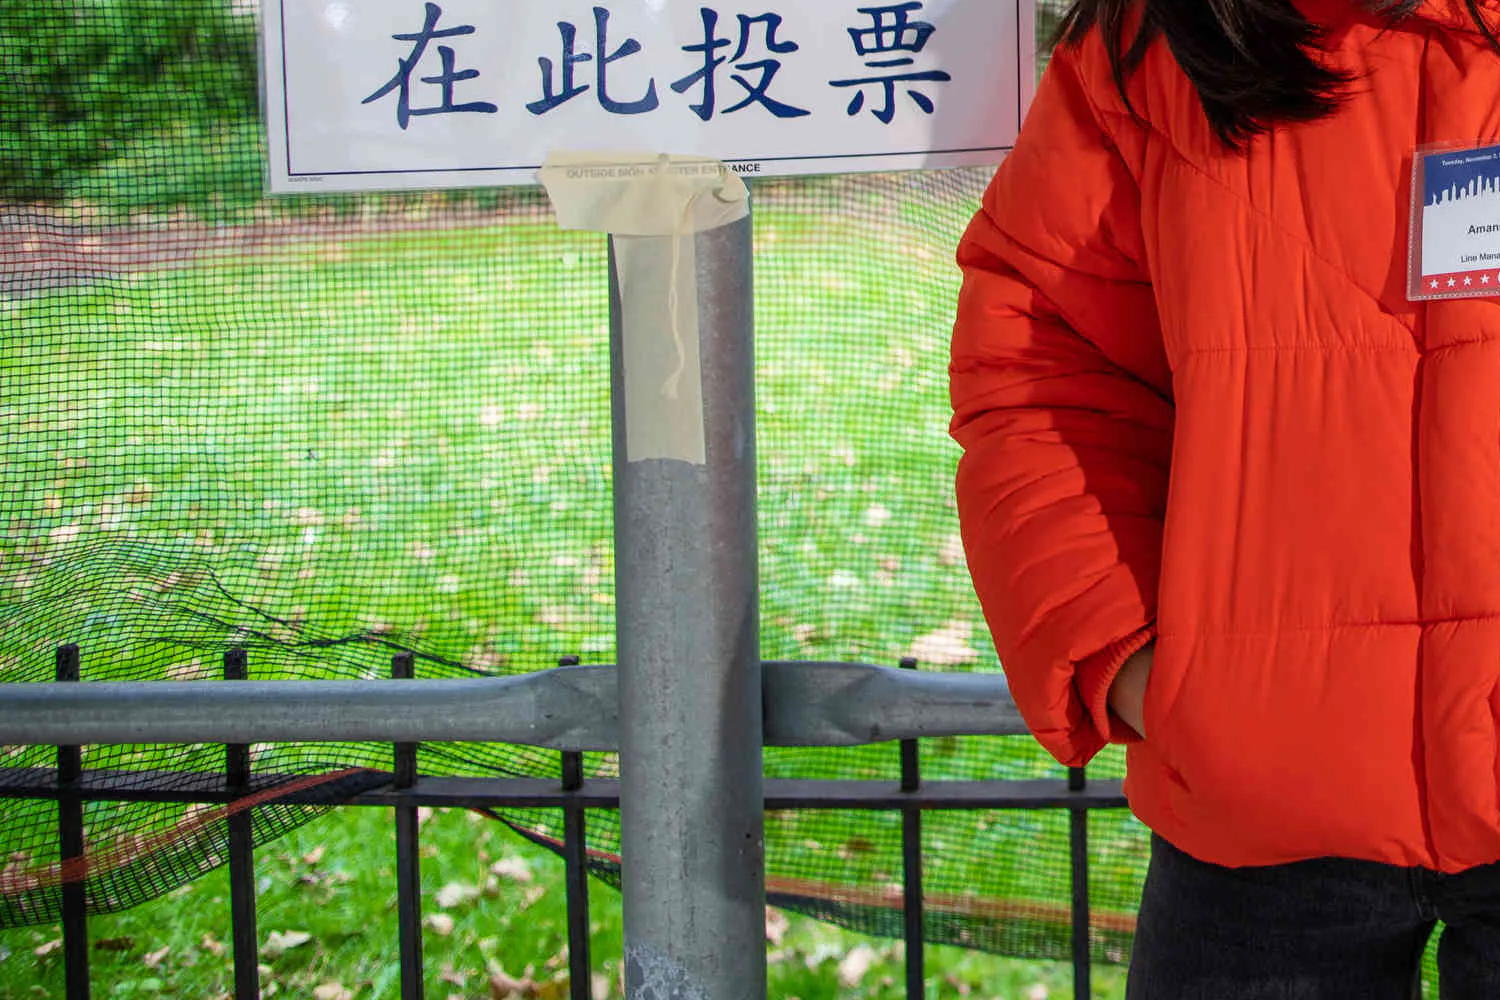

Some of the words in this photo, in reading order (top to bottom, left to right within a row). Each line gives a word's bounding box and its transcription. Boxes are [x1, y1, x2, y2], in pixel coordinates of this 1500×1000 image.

[361, 0, 952, 131] 在此投票
[1460, 254, 1478, 264] Line
